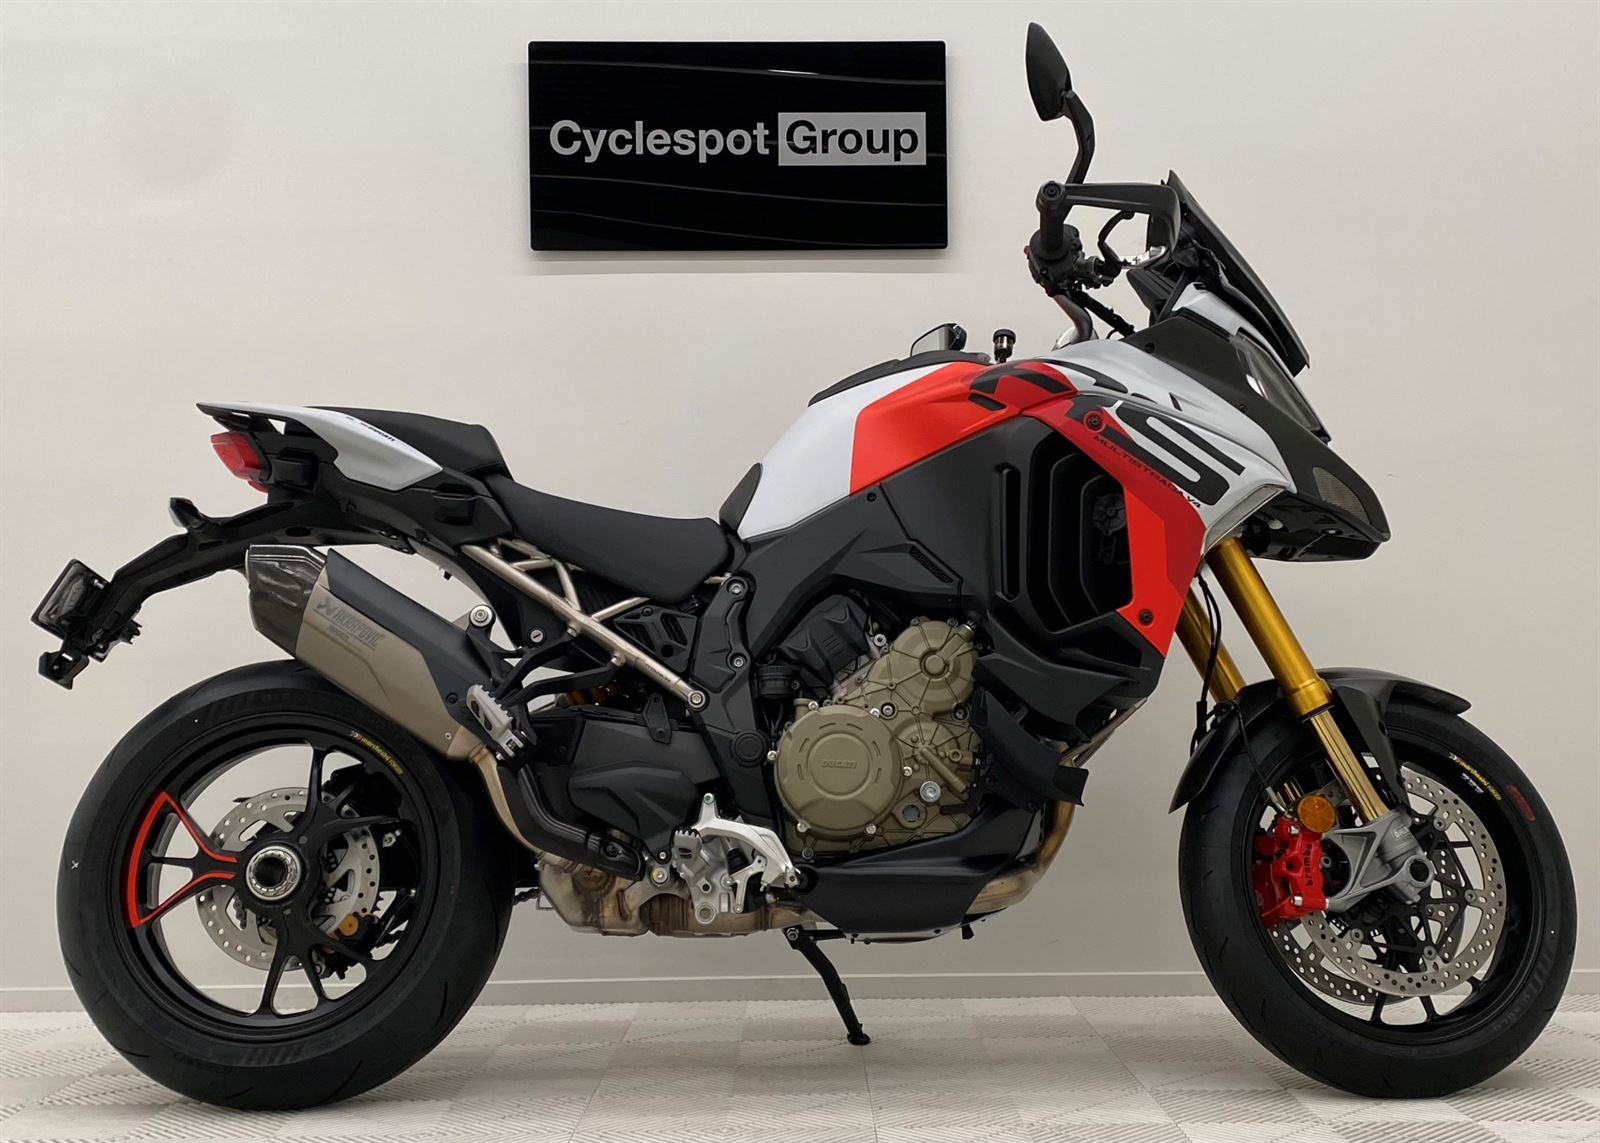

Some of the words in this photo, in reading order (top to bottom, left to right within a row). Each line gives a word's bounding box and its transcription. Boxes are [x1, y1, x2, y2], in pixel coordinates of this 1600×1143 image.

[549, 119, 770, 164] Cyclespot
[785, 119, 920, 162] Group
[1093, 435, 1184, 496] MULTISTRADA
